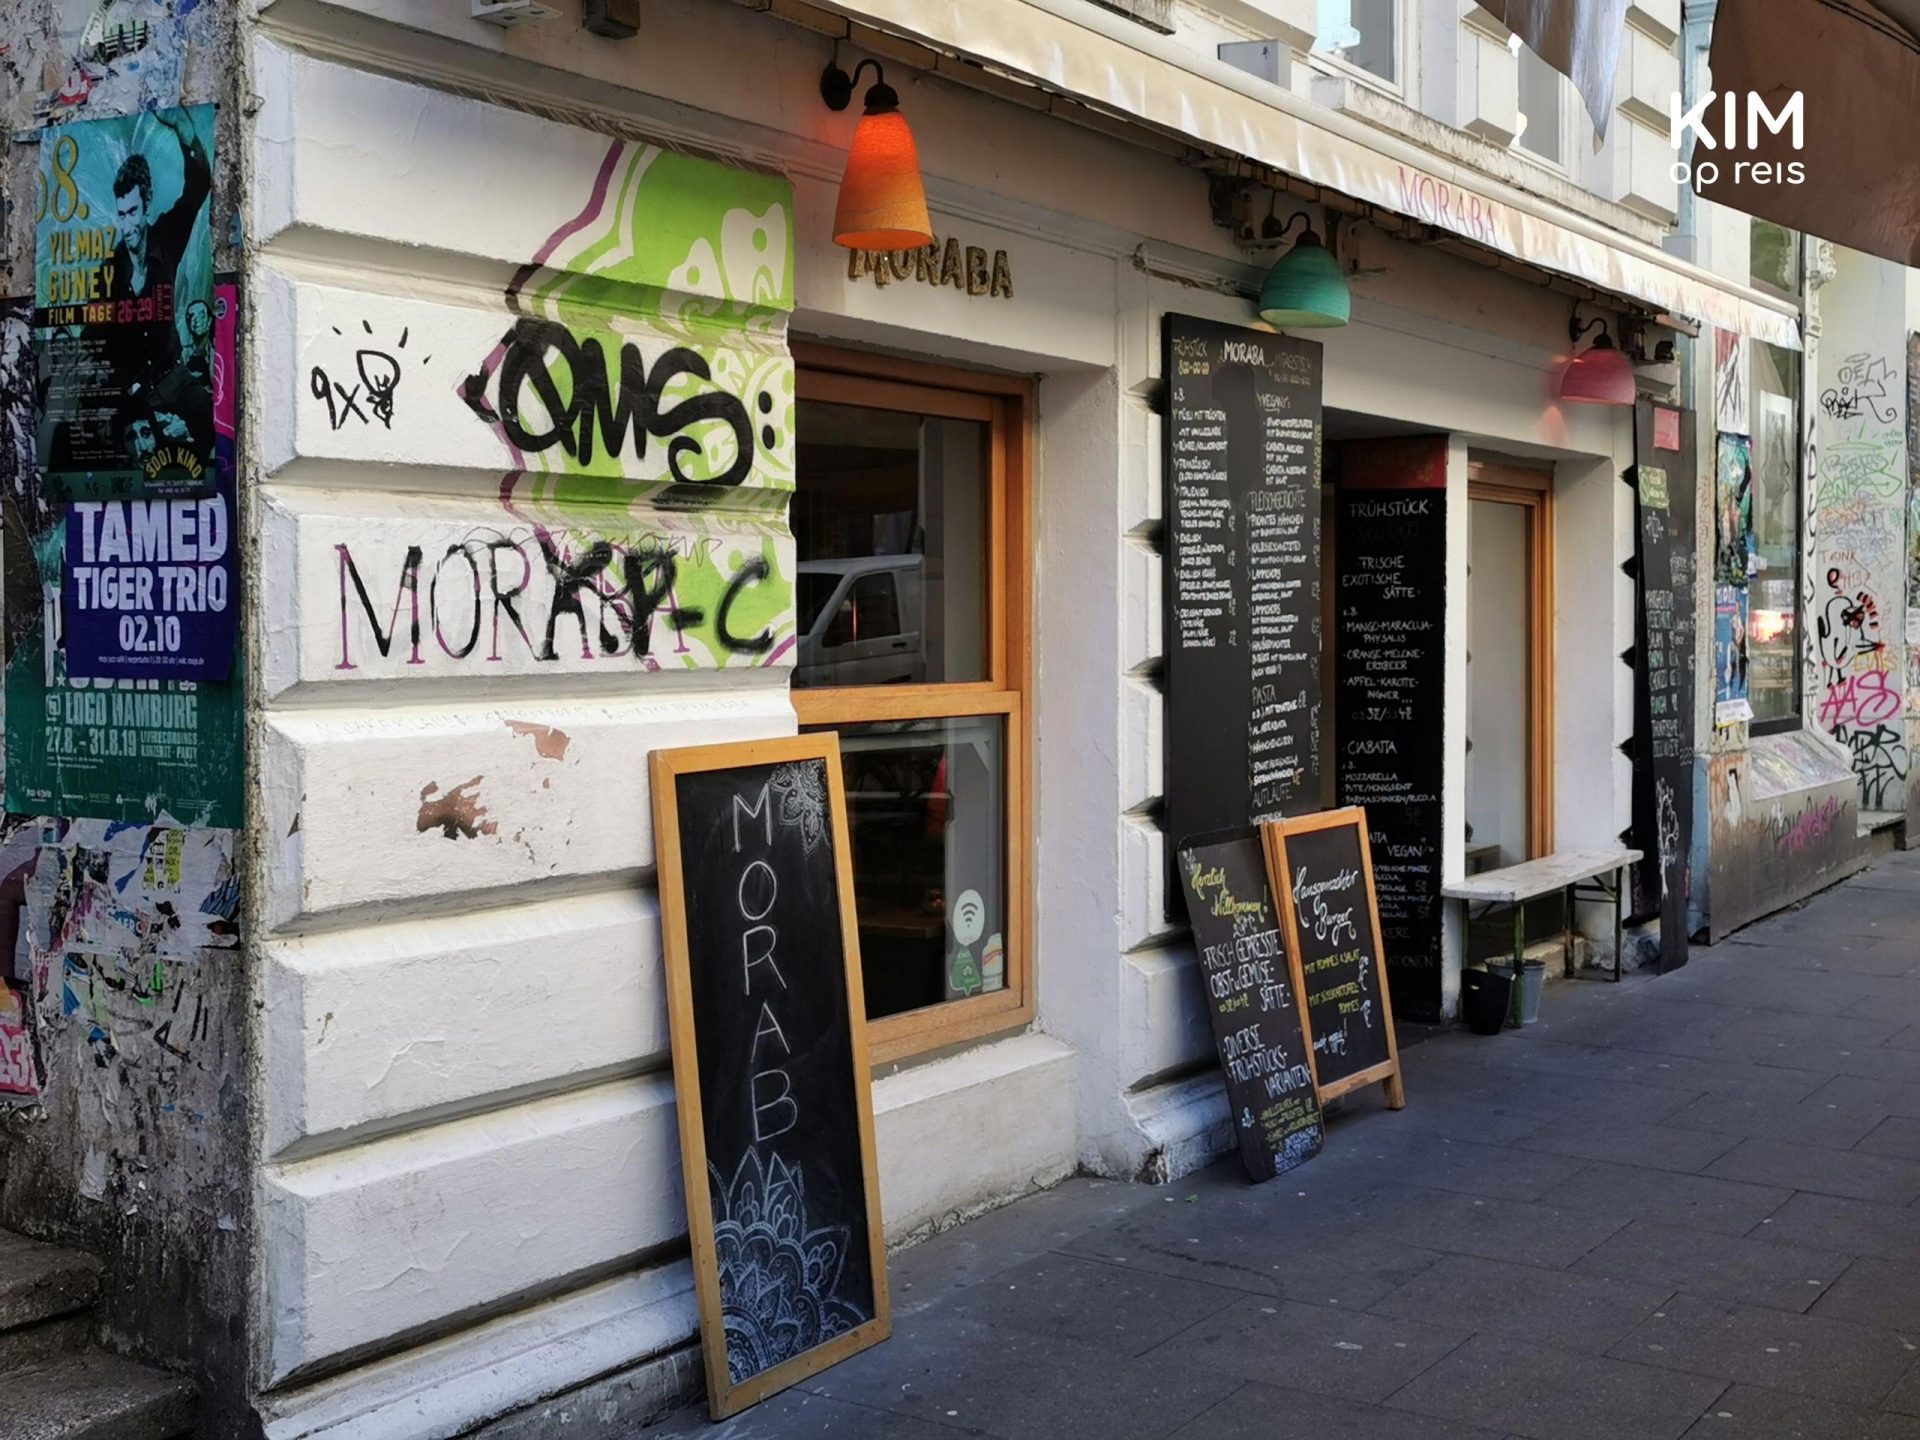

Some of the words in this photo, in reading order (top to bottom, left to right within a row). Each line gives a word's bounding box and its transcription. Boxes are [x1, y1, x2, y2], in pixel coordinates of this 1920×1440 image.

[1398, 165, 1500, 246] MORABA
[49, 226, 115, 263] YILMAZ
[48, 306, 75, 325] FILM
[82, 302, 113, 322] TAGE
[1223, 340, 1265, 366] MORABA
[177, 446, 203, 479] KINO
[74, 493, 228, 563] TAMED
[73, 566, 153, 610] TIGER
[158, 566, 228, 612] TRIO
[1342, 572, 1403, 588] EXOTISCHE
[119, 616, 181, 652] 02.10
[65, 692, 107, 726] LOGO
[112, 692, 198, 730] HAMBURG
[1252, 684, 1276, 706] PASTA
[45, 726, 77, 754] 27.8.
[89, 728, 137, 757] 31.8.19
[1347, 740, 1397, 755] CIABATTA
[1387, 844, 1423, 858] VEGAN
[1315, 903, 1357, 946] Burger
